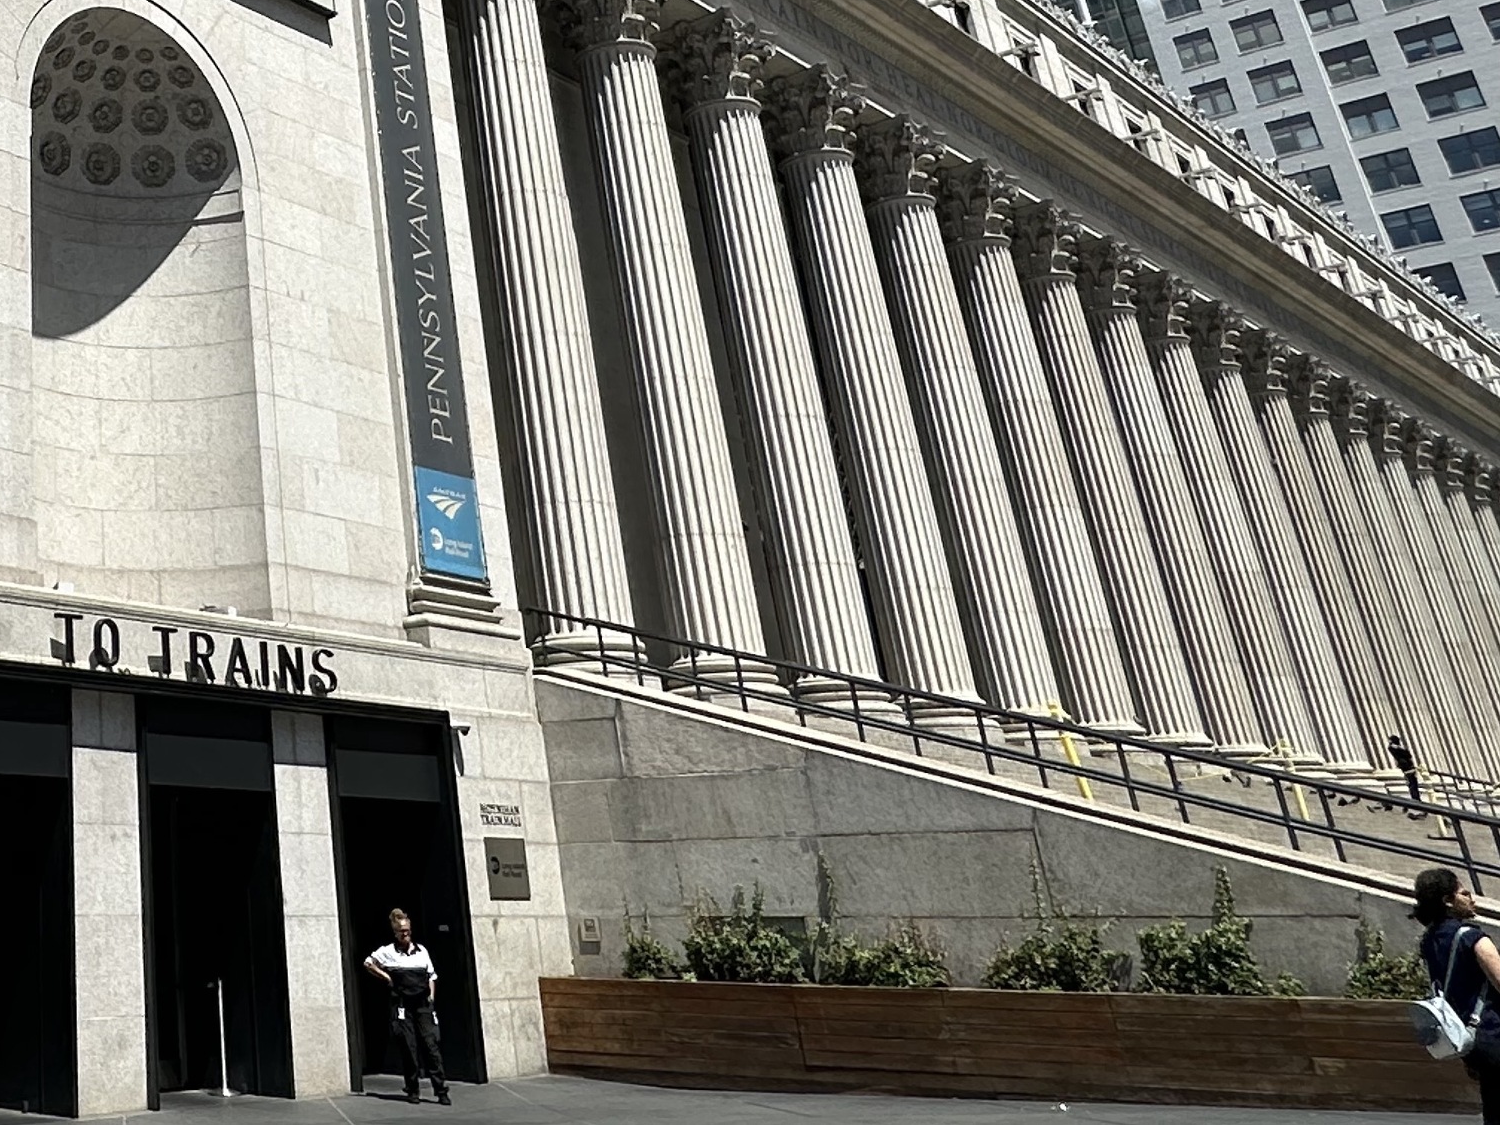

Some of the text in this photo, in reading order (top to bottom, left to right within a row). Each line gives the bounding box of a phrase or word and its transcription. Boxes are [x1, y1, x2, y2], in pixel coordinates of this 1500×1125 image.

[401, 144, 454, 445] PENNSYLVANIA
[53, 612, 338, 695] TO TRAINS
